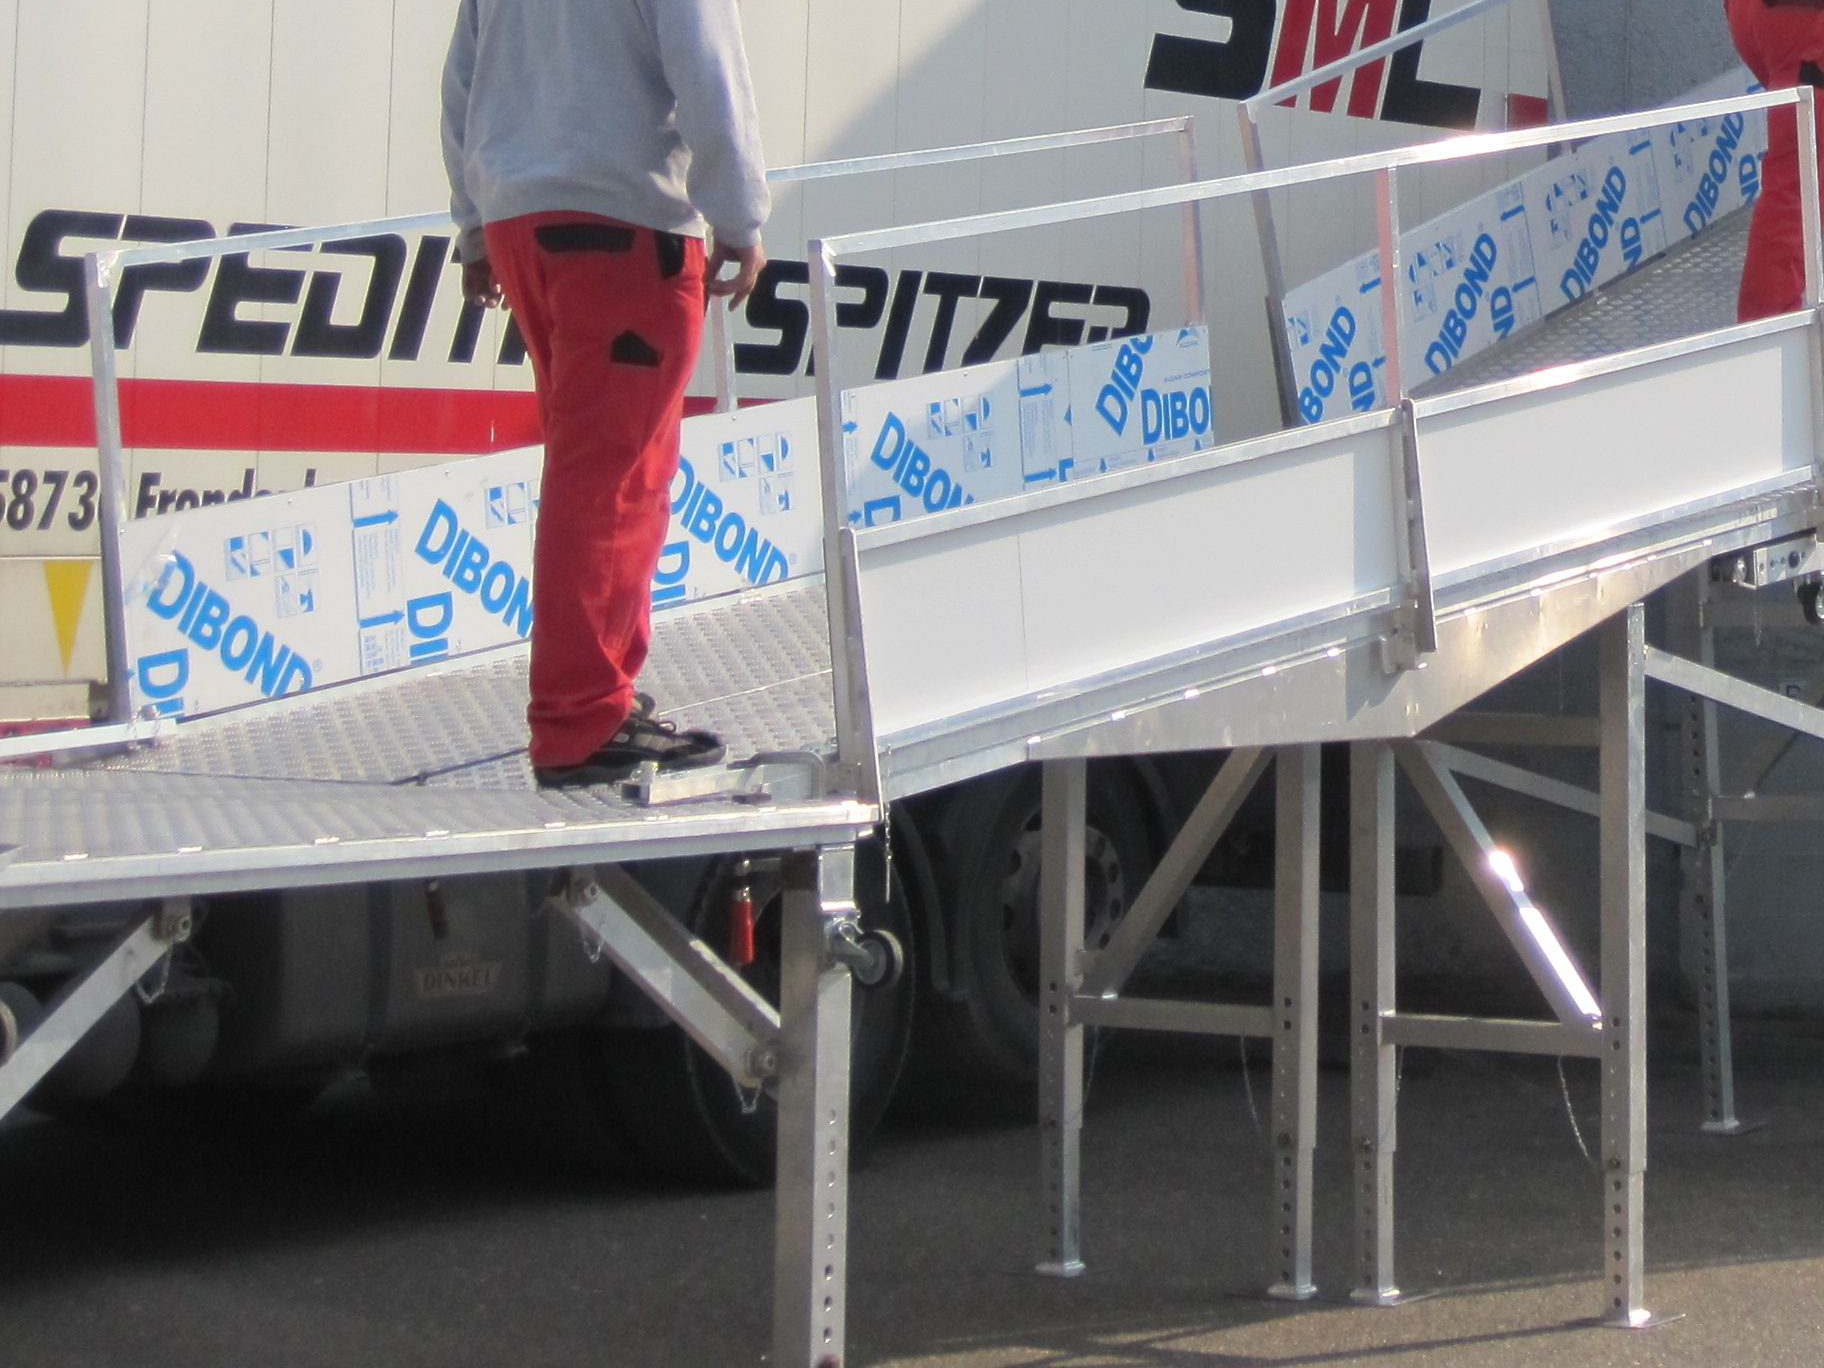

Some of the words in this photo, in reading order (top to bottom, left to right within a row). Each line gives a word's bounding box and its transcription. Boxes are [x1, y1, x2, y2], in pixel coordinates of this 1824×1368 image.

[1424, 233, 1497, 375] DIBOND
[1560, 166, 1626, 301] DIBOND
[146, 549, 313, 697] DIBOND
[414, 498, 536, 639] DIBON
